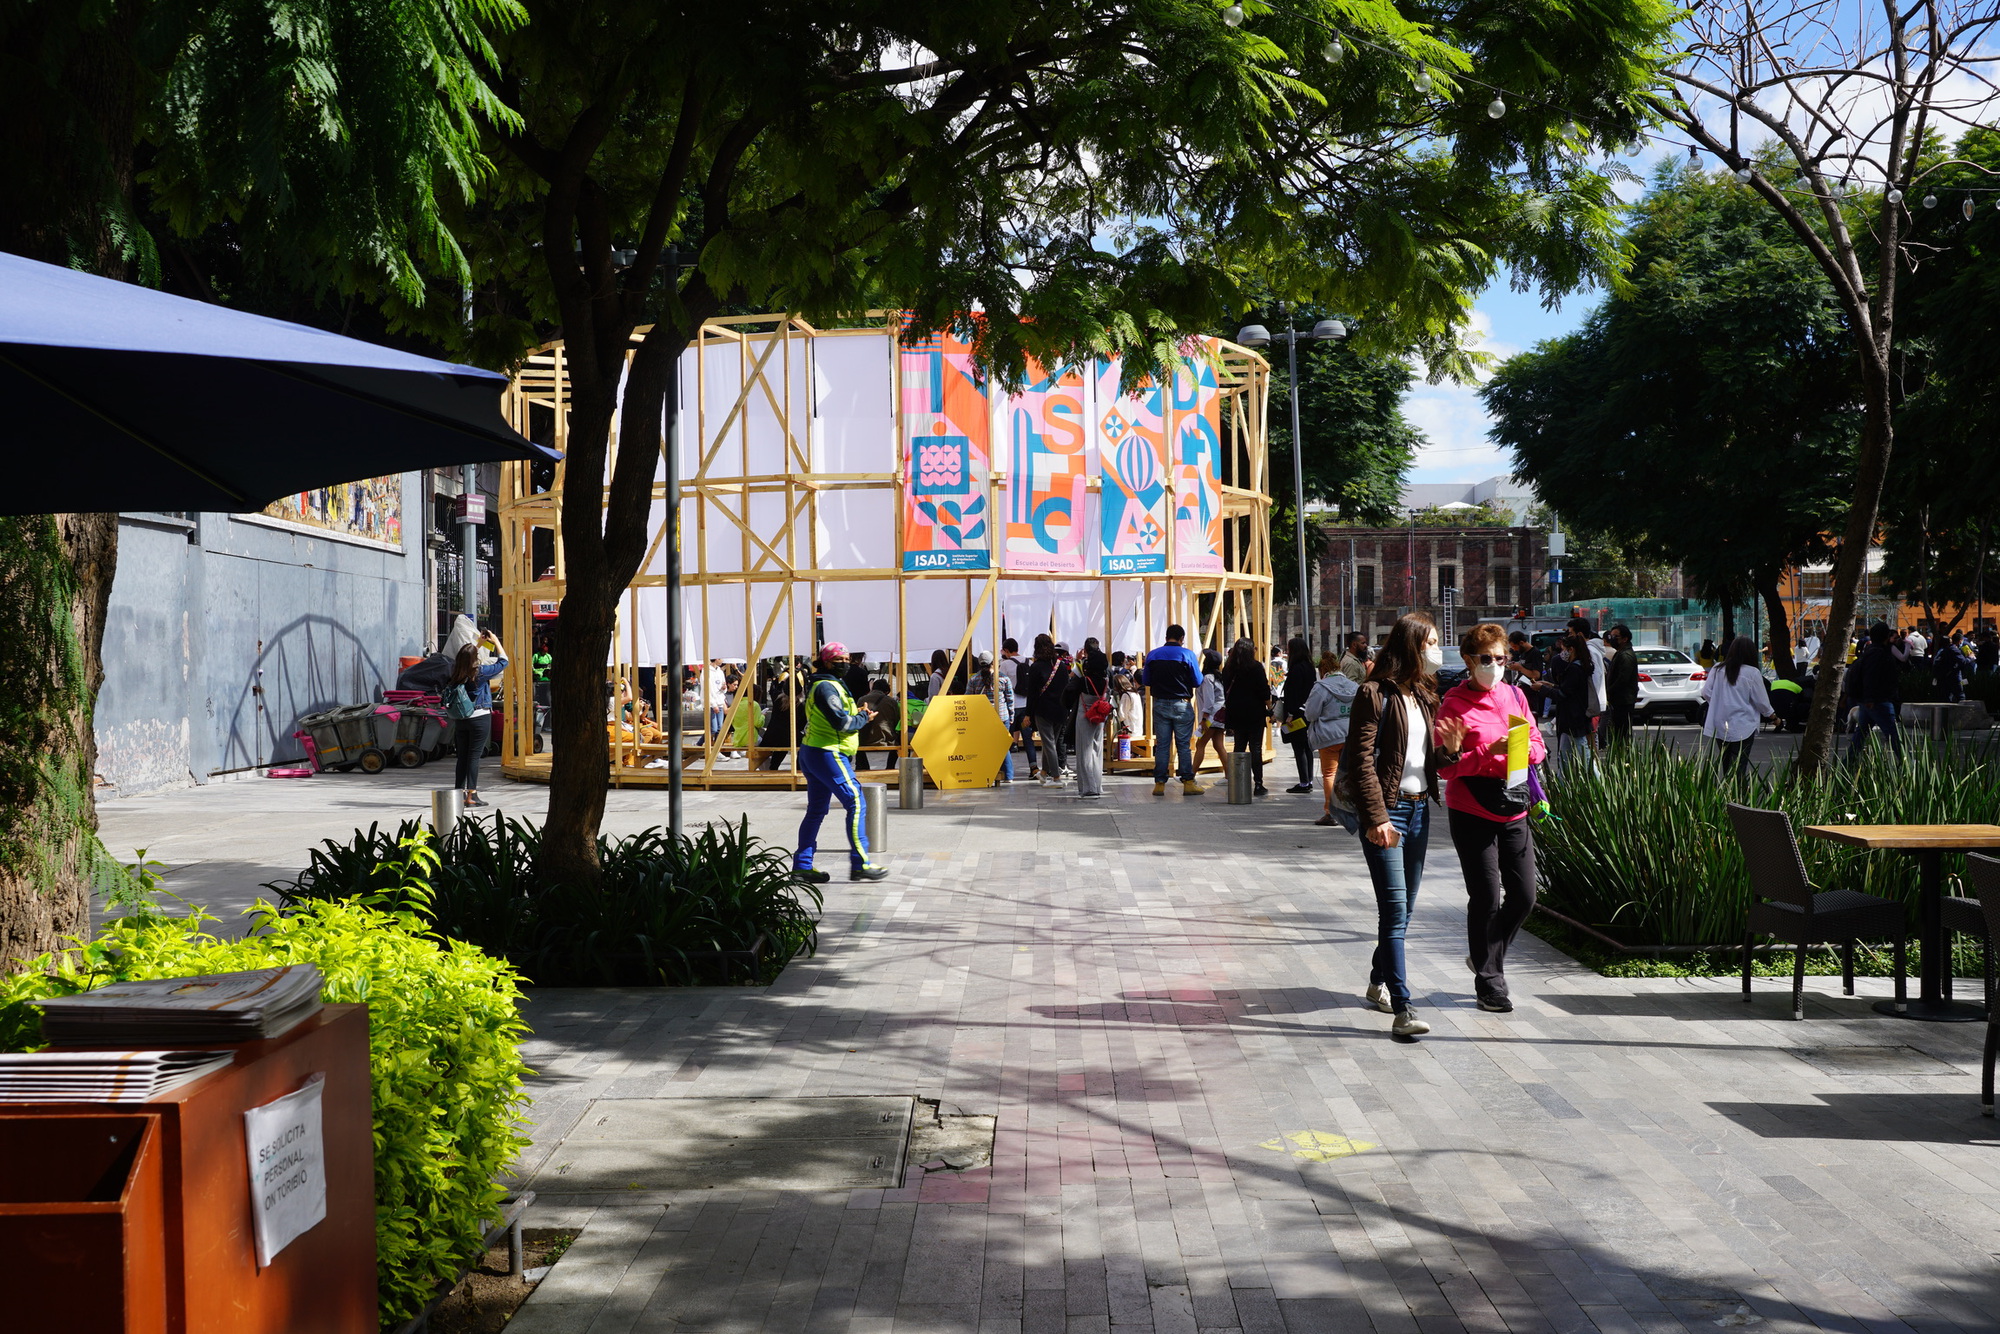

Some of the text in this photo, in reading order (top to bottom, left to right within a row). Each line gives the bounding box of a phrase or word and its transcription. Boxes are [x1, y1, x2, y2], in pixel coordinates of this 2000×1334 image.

[260, 1123, 306, 1164] SE SOLICITA
[264, 1148, 304, 1186] PERSONAL
[277, 1169, 308, 1200] TORIBIO
